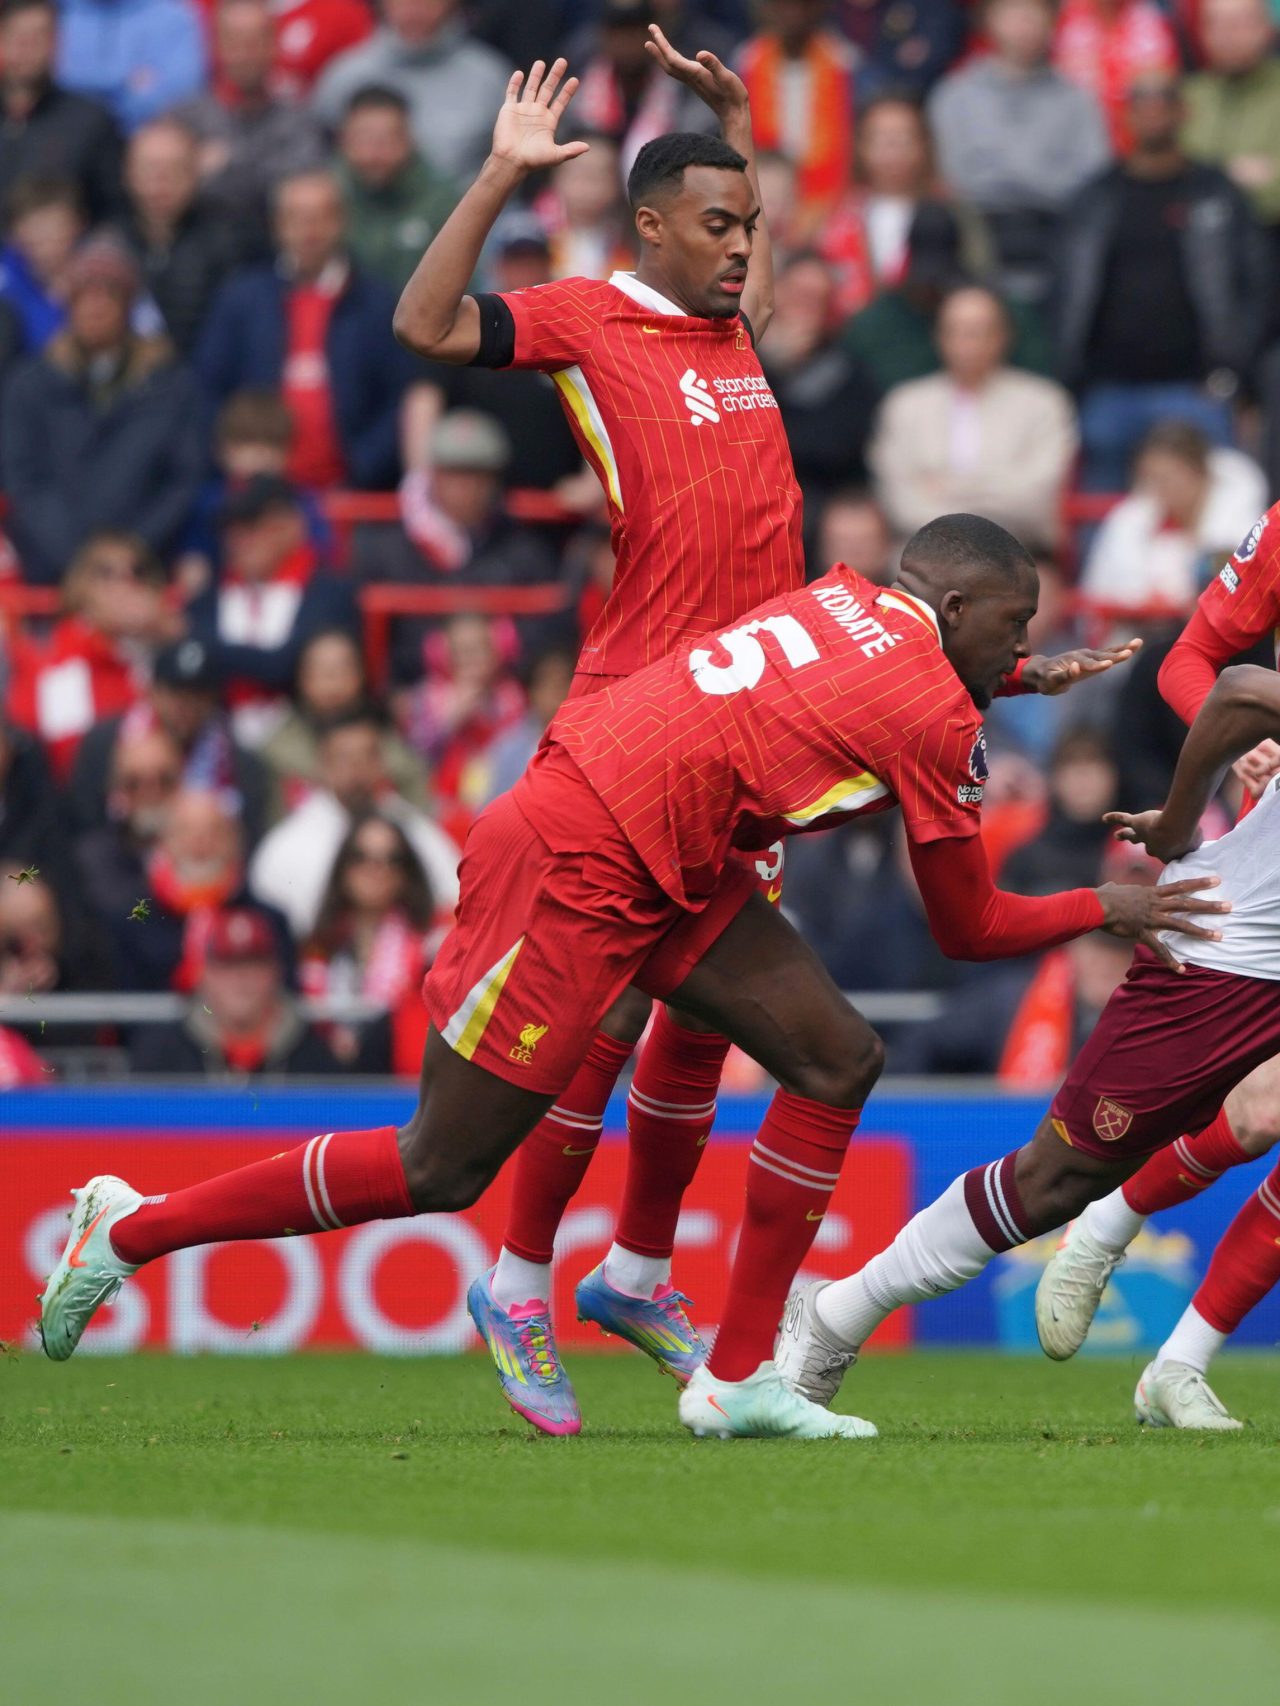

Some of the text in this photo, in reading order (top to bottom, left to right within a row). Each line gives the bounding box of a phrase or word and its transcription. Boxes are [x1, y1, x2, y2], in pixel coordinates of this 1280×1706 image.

[688, 613, 821, 696] 5
[811, 583, 904, 659] KONATÉ
[957, 784, 971, 794] No
